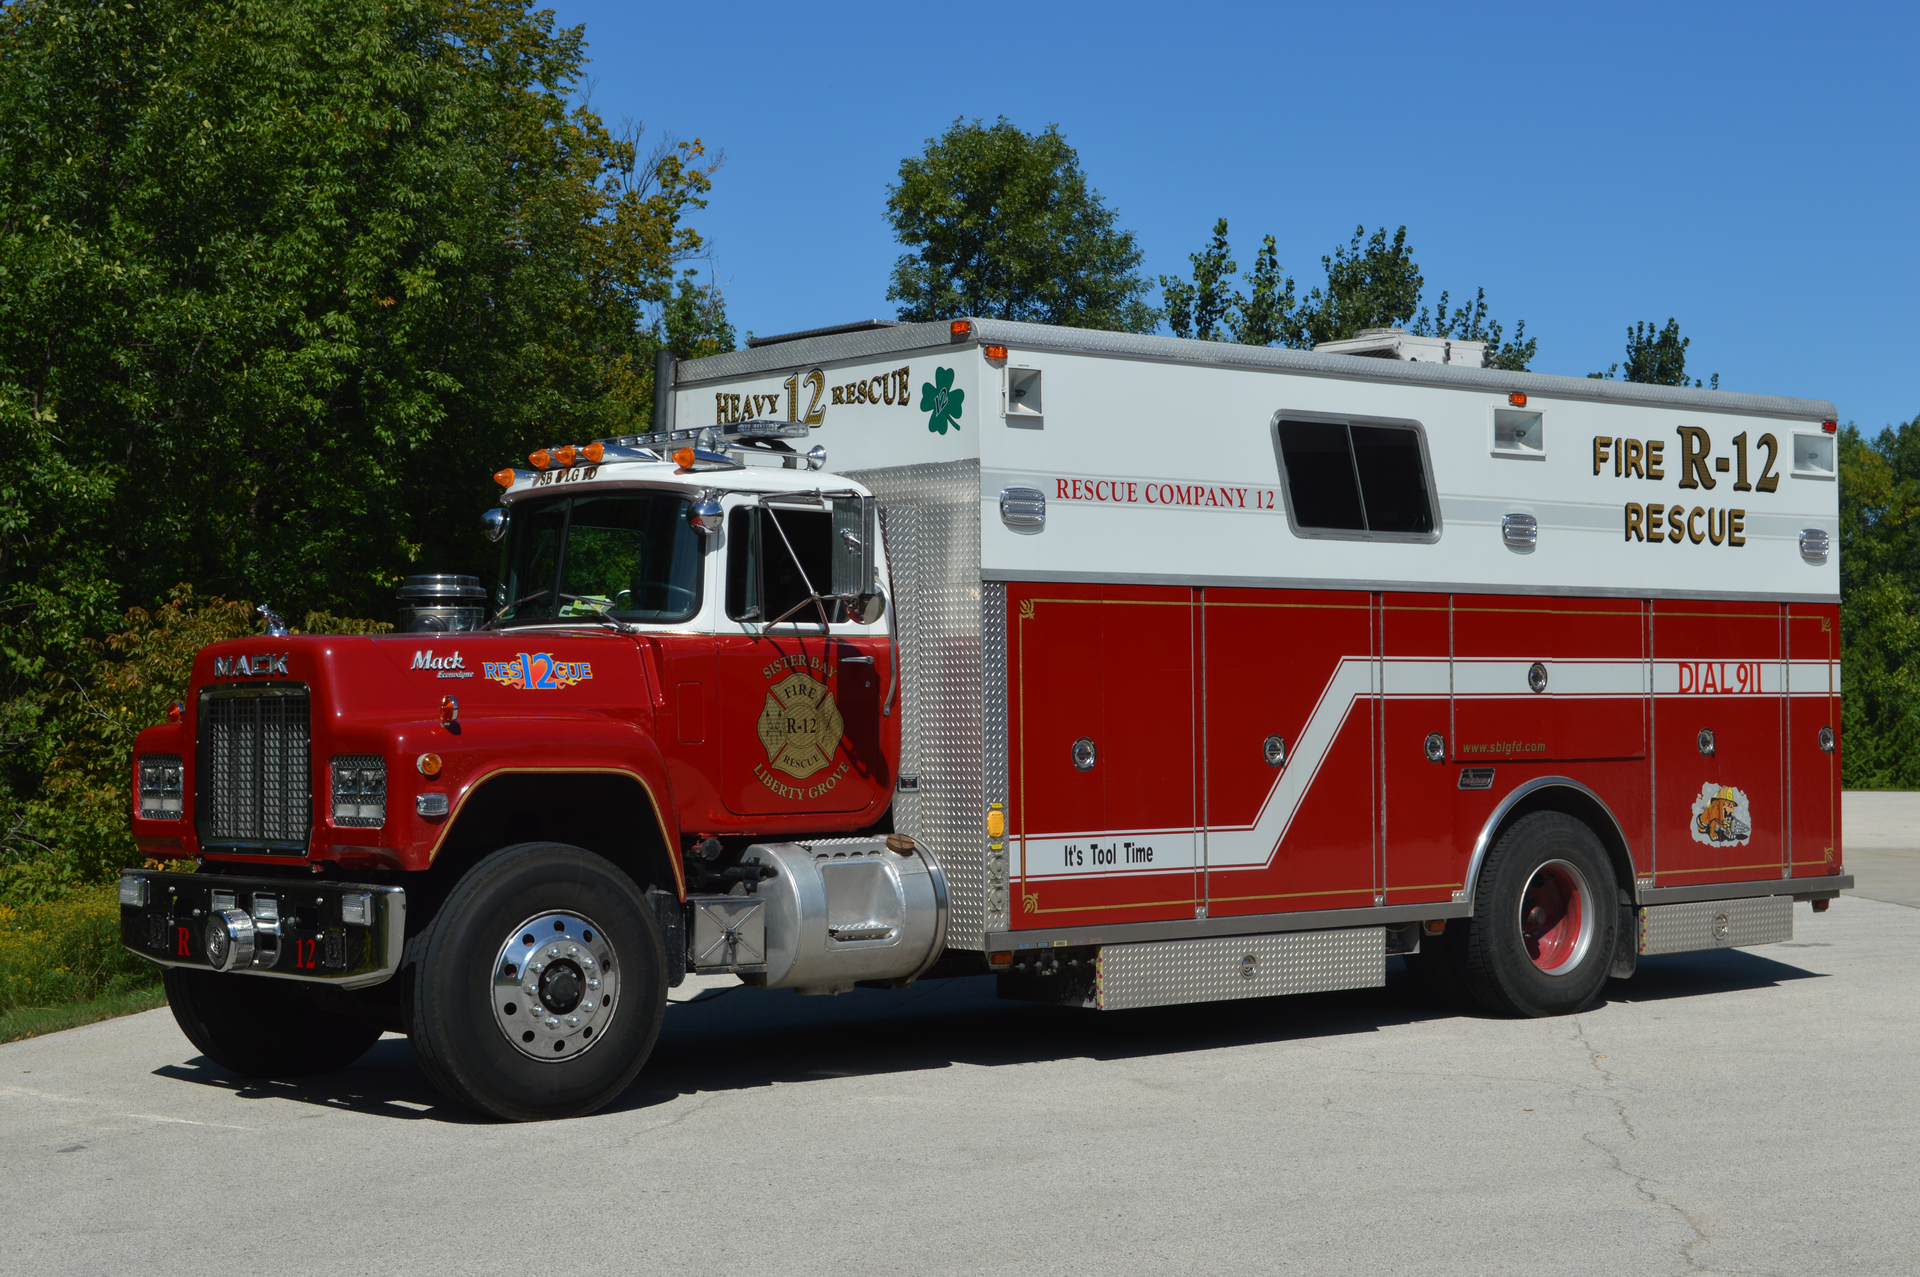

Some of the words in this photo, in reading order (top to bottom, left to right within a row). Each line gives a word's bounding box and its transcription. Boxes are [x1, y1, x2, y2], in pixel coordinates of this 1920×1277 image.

[716, 392, 780, 424] HEAVY
[784, 368, 826, 428] 12
[831, 365, 911, 406] RESCUE
[934, 387, 949, 417] 12
[1593, 436, 1665, 480] FIRE
[1676, 425, 1780, 493] R-12
[540, 471, 553, 486] SB
[565, 467, 579, 482] LG
[1055, 478, 1139, 503] RESCUE
[1145, 483, 1248, 508] COMPANY
[1256, 490, 1275, 509] 12
[1624, 502, 1746, 547] RESCUE
[214, 652, 289, 677] MACK
[410, 649, 466, 670] Mack
[762, 654, 808, 680] SISTER
[810, 656, 838, 679] BAY
[1679, 662, 1734, 693] DIAL
[1736, 663, 1763, 693] 911
[783, 684, 817, 700] FIRE
[786, 717, 817, 734] R-12
[783, 754, 821, 769] RESCUE
[1462, 741, 1546, 756] www.sblgfd.com
[752, 763, 805, 800] LIBERTY
[808, 761, 850, 799] GROVE
[1064, 844, 1084, 867] It's
[1090, 843, 1117, 865] Tool
[1124, 842, 1154, 863] Time
[177, 926, 191, 957] R
[296, 939, 316, 969] 12
